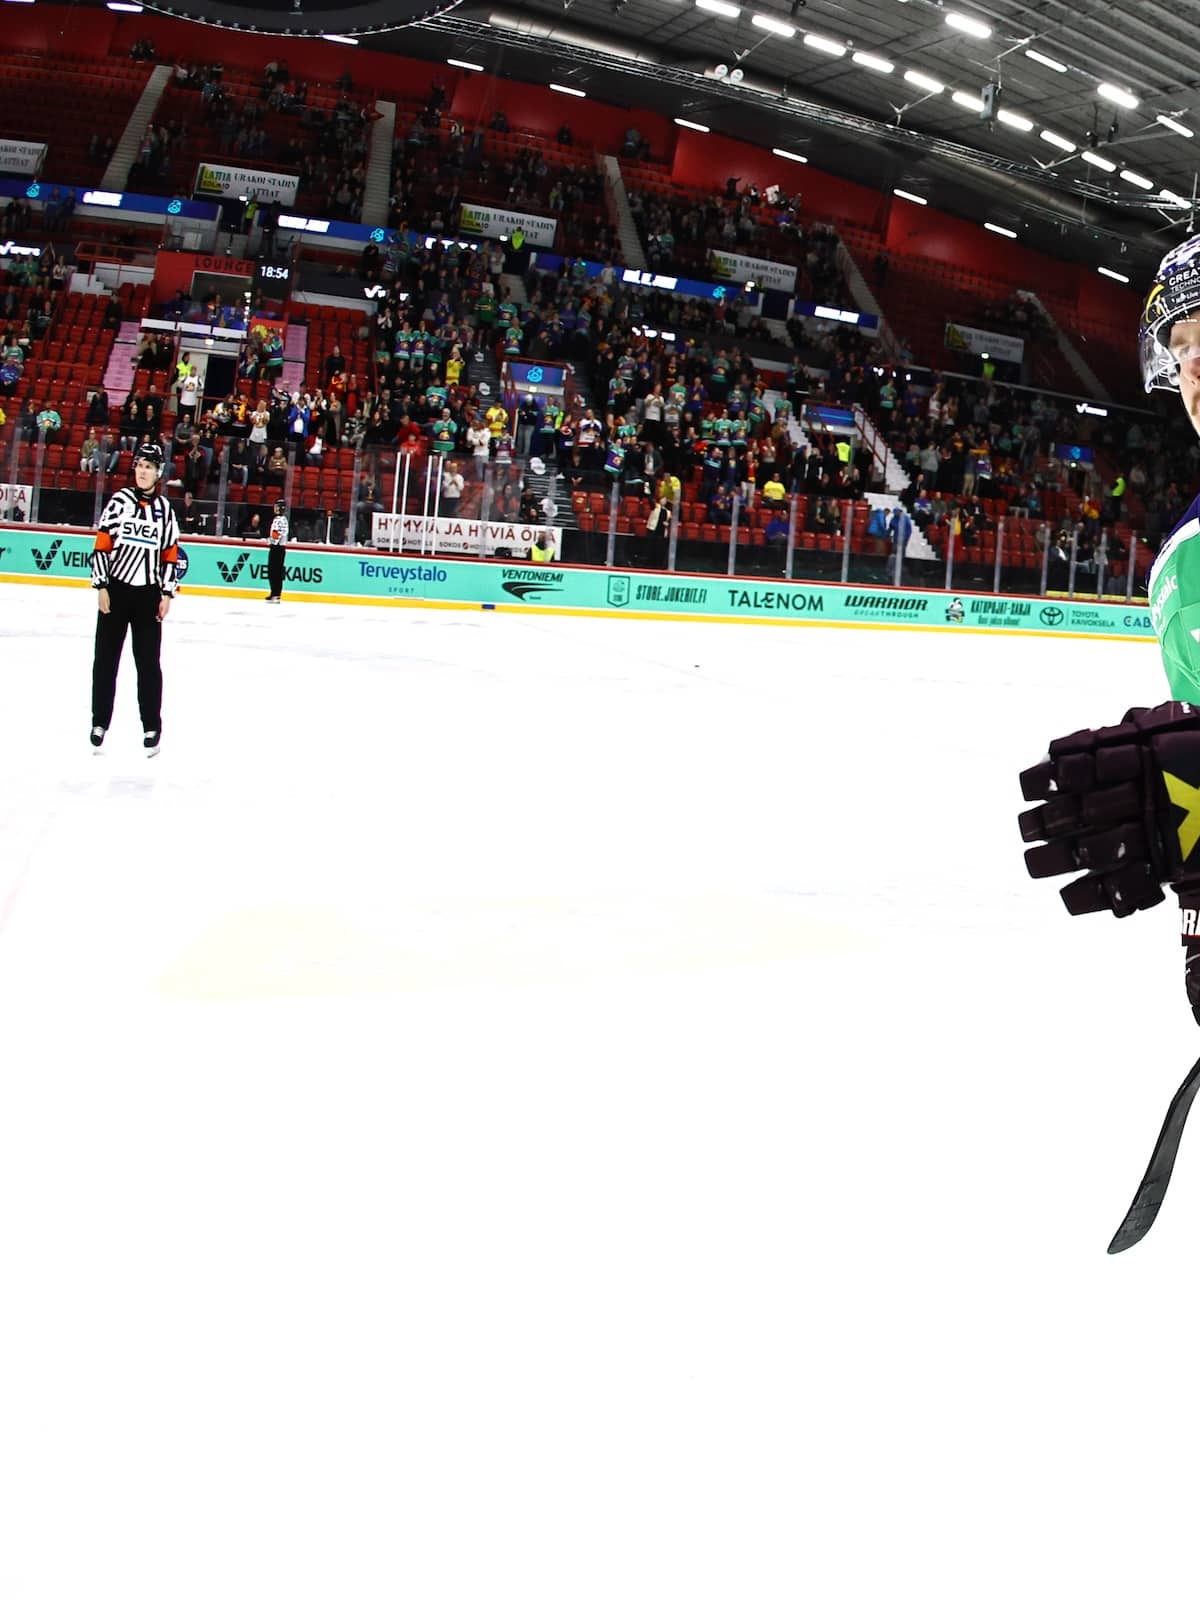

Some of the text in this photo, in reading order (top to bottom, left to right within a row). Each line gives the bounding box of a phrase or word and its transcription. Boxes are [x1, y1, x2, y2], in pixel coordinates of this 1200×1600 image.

[194, 257, 253, 273] LOUNGE
[260, 265, 289, 280] 18:54
[123, 521, 159, 539] SVEA
[445, 523, 463, 537] JA
[469, 524, 516, 541] HYVIÄ
[439, 541, 461, 549] SOKOS
[249, 562, 323, 584] VEKAUS
[358, 561, 448, 583] Terveystalo
[502, 569, 564, 583] VENTONIEMI
[728, 589, 825, 612] TALENOM
[844, 594, 929, 612] WARRIOR
[1071, 610, 1100, 619] TOYOTA
[1123, 615, 1153, 629] CAB
[1070, 618, 1116, 628] KAIVOKSELA
